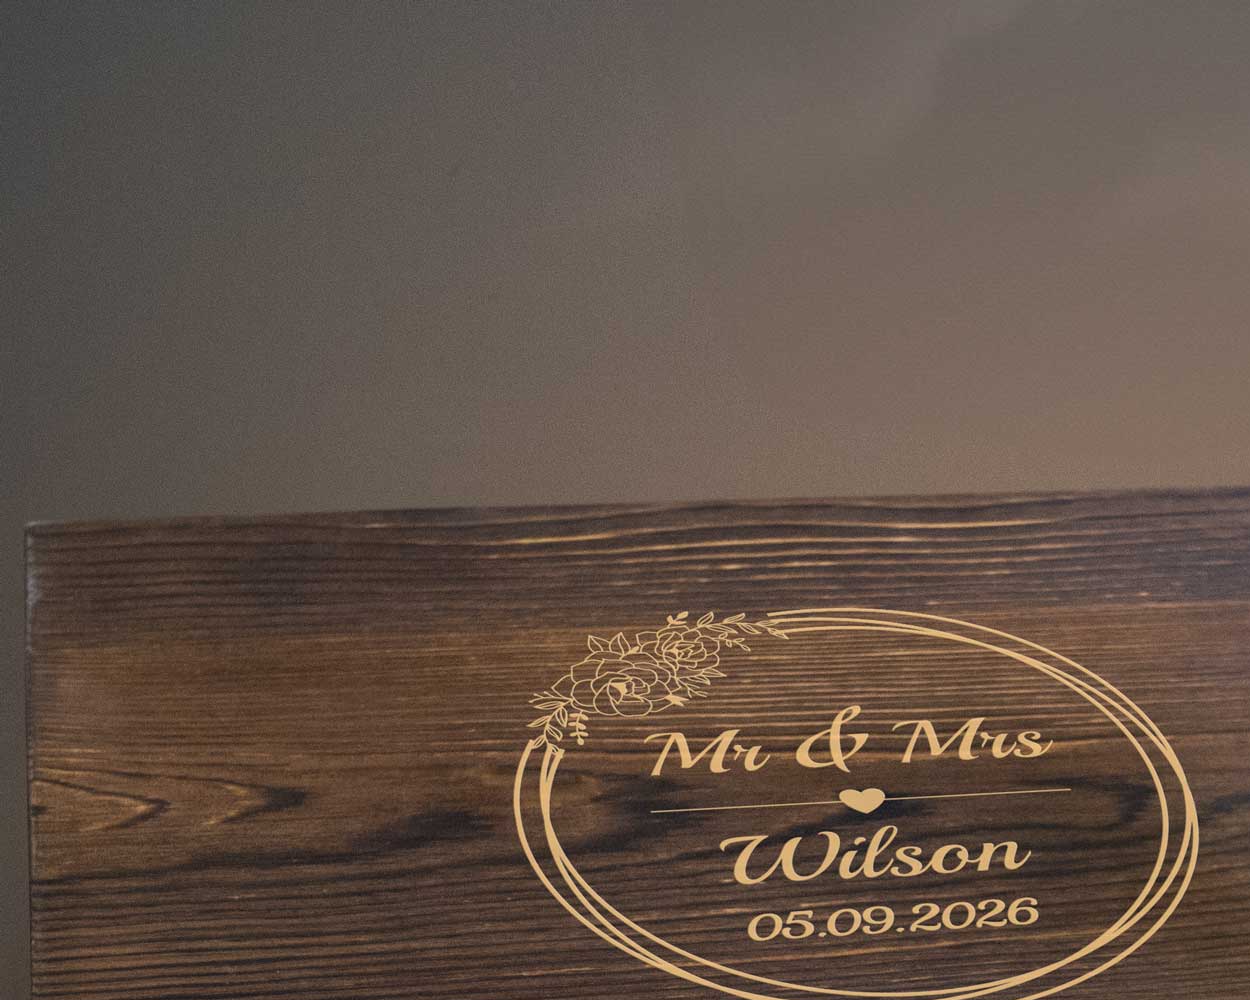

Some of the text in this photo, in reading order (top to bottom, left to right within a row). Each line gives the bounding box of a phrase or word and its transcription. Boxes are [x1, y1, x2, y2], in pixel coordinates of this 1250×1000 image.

[643, 705, 1054, 776] Mr & Mrs
[719, 825, 1032, 885] Wilson
[746, 897, 1040, 942] 05.09.2026
